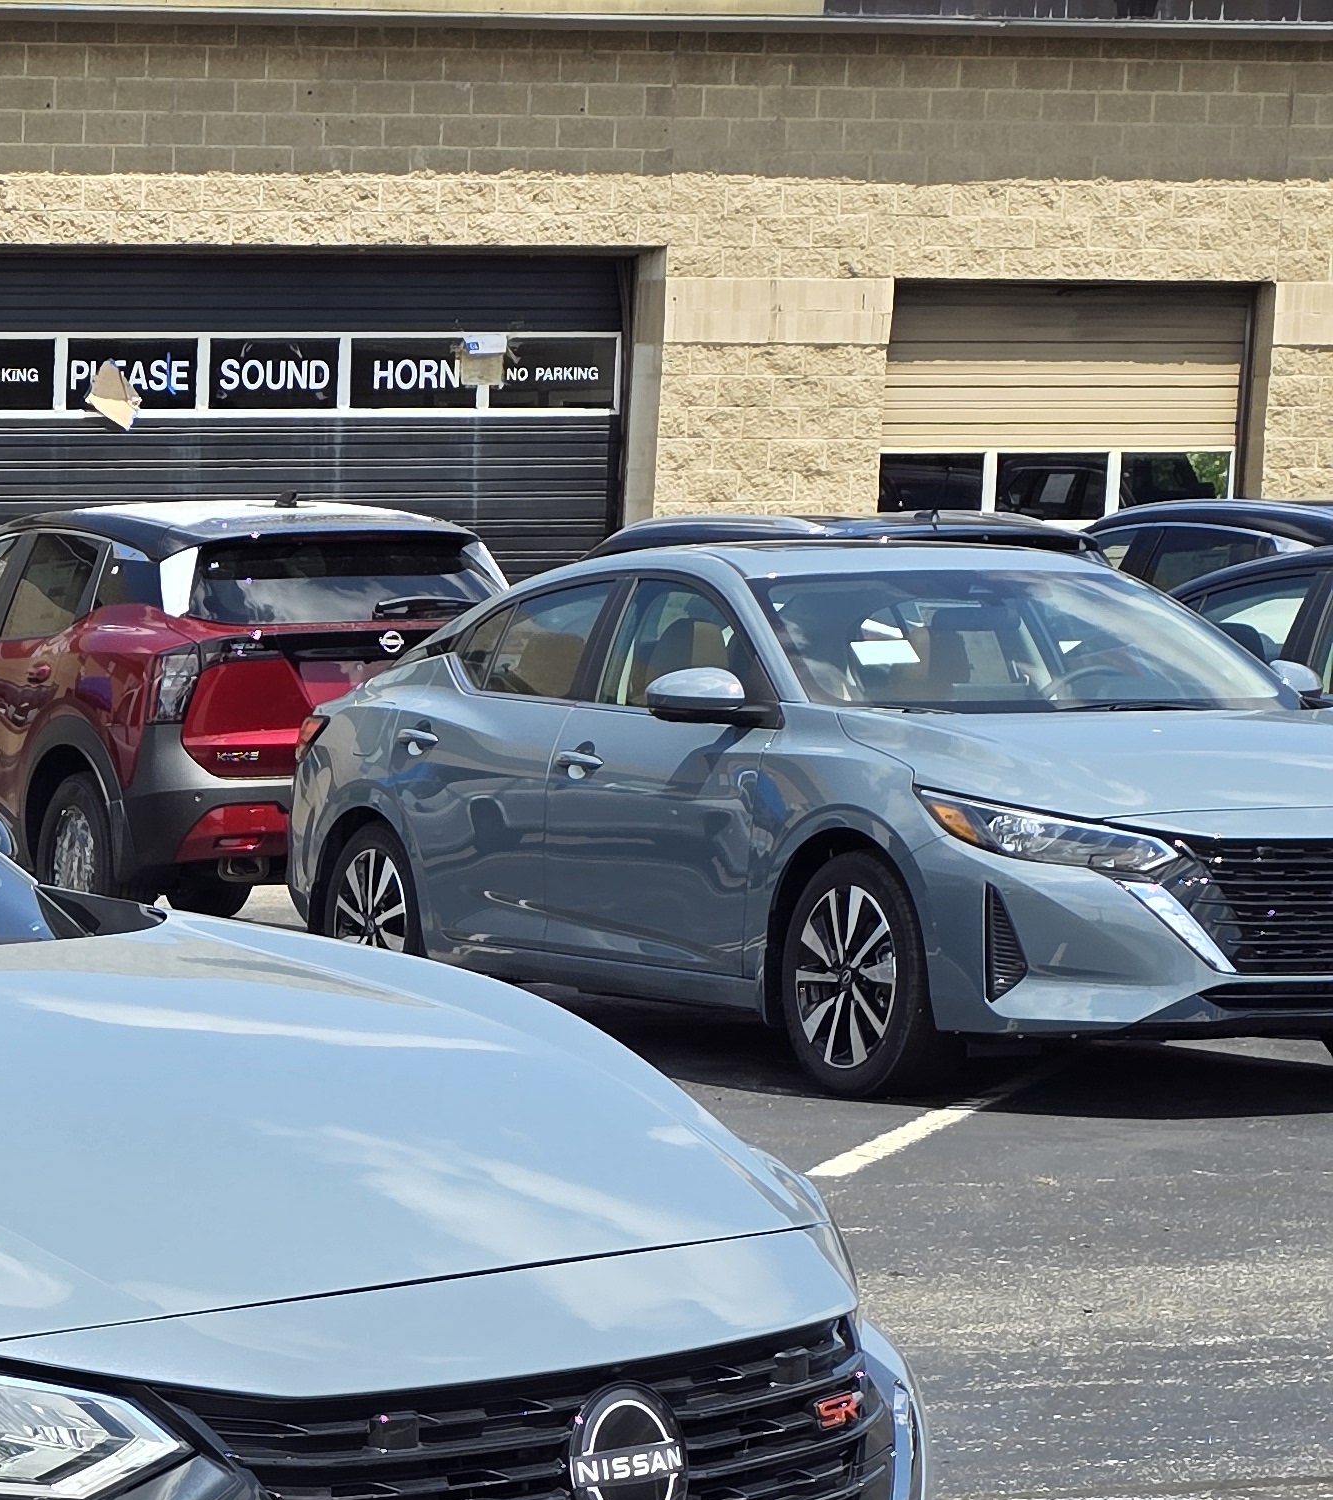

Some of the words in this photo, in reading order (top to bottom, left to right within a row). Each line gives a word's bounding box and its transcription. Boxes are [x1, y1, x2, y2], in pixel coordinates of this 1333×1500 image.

[70, 360, 190, 390] PASE
[219, 358, 330, 390] SOUND
[373, 359, 460, 389] HORN
[506, 367, 529, 381] NO
[535, 367, 599, 381] PARKING
[815, 1390, 863, 1431] SR
[577, 1445, 683, 1483] NISSAN
